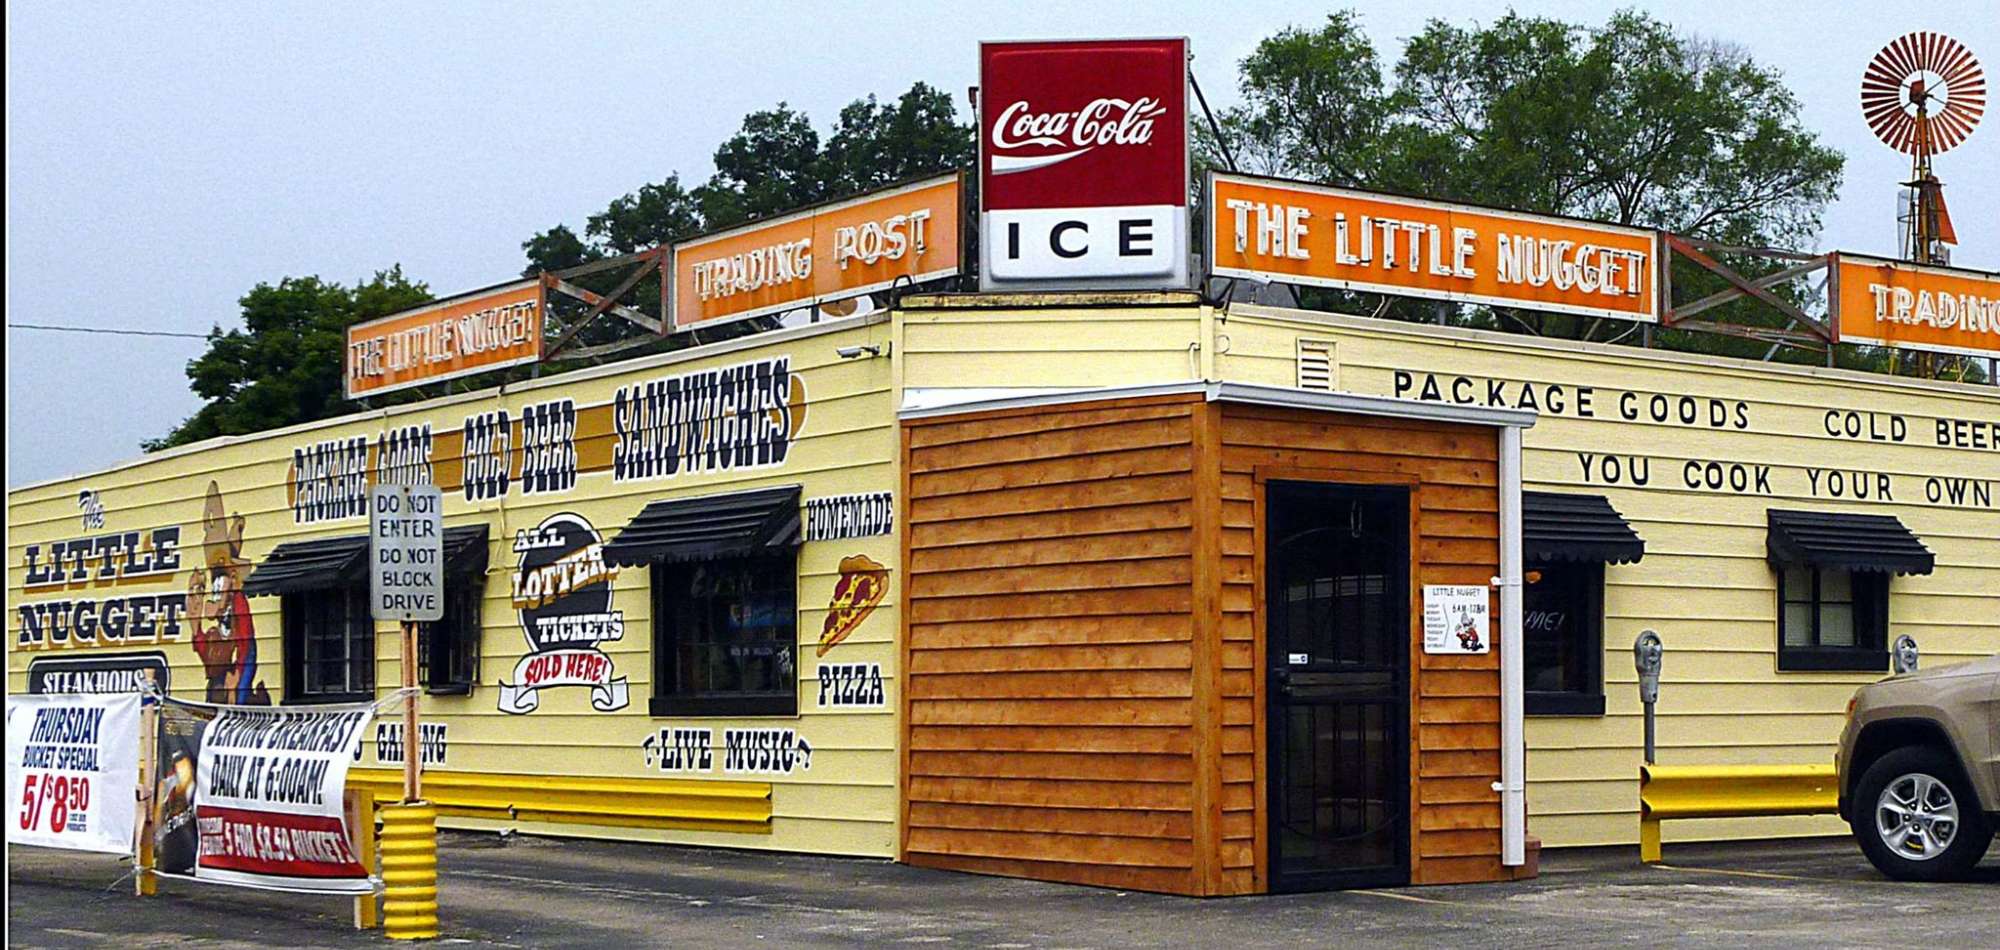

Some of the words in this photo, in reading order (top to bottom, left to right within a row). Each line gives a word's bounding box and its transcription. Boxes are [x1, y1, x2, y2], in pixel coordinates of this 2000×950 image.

[992, 97, 1166, 149] Coca-Cola
[691, 237, 813, 301] TRADING
[833, 208, 931, 270] POST
[1008, 218, 1153, 260] ICE
[1227, 198, 1310, 259] THE
[1334, 212, 1478, 279] LITTLE
[1497, 233, 1647, 297] NUGGET
[350, 335, 386, 380] THE
[387, 319, 454, 372] LITTLE
[454, 299, 537, 357] NUGGET
[1393, 371, 1594, 417] PACKAGE
[1619, 391, 1749, 429] GOODS
[1824, 409, 1907, 442] COLD
[293, 436, 368, 524] PACKAGE
[377, 423, 433, 485] GOODS
[464, 410, 512, 501] COLD
[522, 398, 578, 494] BEER
[614, 357, 792, 481] SANDWICHES
[1577, 454, 1649, 486] YOU
[1683, 460, 1772, 494] COOK
[1806, 468, 1893, 501] YOUR
[1925, 477, 1991, 507] OWN
[79, 489, 105, 531] The
[377, 495, 399, 513] DO
[406, 494, 437, 513] NOT
[807, 492, 894, 542] HOMEMADE
[379, 519, 435, 538] ENTER
[514, 528, 566, 552] ALL
[25, 526, 181, 587] LITTLE
[379, 548, 401, 565] DO
[406, 548, 437, 565] NOT
[512, 542, 619, 606] LOTTER
[382, 571, 433, 587] BLOCK
[1432, 587, 1455, 597] LITTLE
[1456, 587, 1481, 597] NUGGET
[17, 593, 188, 647] NUGGET
[382, 595, 436, 610] DRIVE
[536, 611, 624, 643] TICKETS
[42, 668, 145, 695] STEAKHOUS
[525, 654, 562, 687] SOLD
[565, 654, 608, 684] HERE!
[817, 665, 885, 706] PIZZA
[29, 707, 106, 744] THURSDAY
[207, 709, 282, 749] SERVING
[266, 711, 366, 753] BREAKFAST
[377, 724, 448, 764] GANG
[22, 745, 57, 769] BUCKET
[57, 746, 100, 772] SPECIAL
[660, 729, 712, 770] LIVE
[725, 730, 794, 772] MUSIC
[209, 754, 247, 798] DAILY
[245, 756, 266, 800] AT
[265, 756, 330, 805] 6:00AM!
[224, 822, 233, 856] 5
[233, 823, 258, 858] FOR
[257, 822, 295, 862] $8.50
